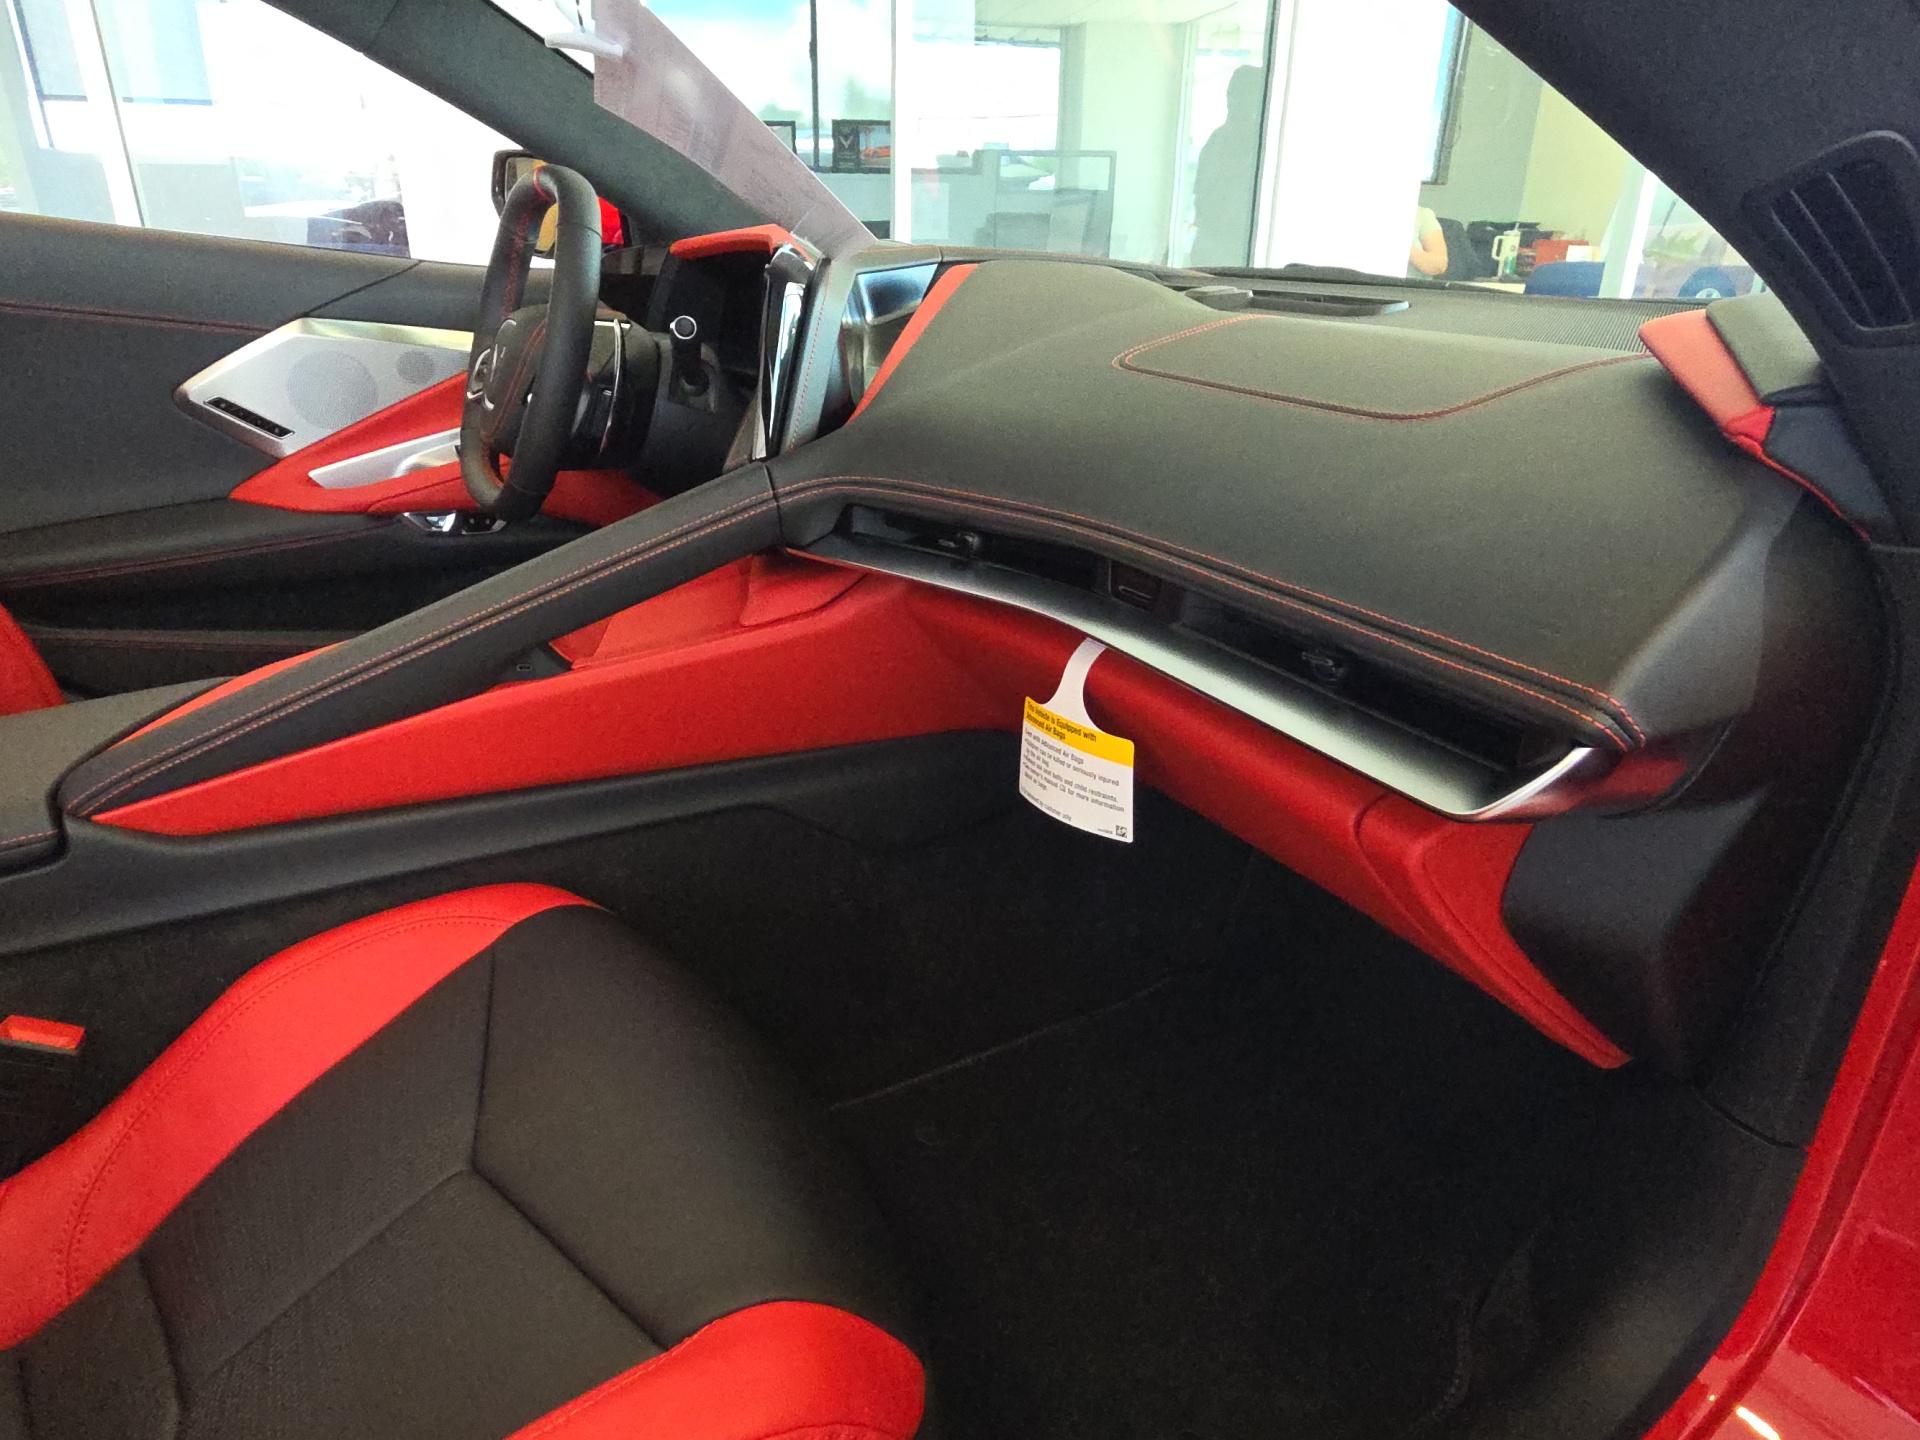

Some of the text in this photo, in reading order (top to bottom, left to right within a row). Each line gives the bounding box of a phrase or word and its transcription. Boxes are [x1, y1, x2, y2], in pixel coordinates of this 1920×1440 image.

[1026, 712, 1045, 729] Advanced
[1053, 727, 1066, 741] Bags
[1035, 706, 1050, 721] Vehicle
[1051, 715, 1056, 724] is
[1056, 719, 1082, 736] Equipped
[1083, 730, 1097, 742] with
[1039, 748, 1047, 756] can
[1053, 756, 1066, 766] killed
[1072, 766, 1096, 780] seriously
[1098, 775, 1120, 787] injured
[1041, 739, 1062, 754] Advanced
[1062, 750, 1070, 758] Air
[1070, 754, 1084, 765] Bags
[1043, 766, 1052, 776] seat
[1052, 772, 1063, 782] belts
[1064, 778, 1074, 787] and
[1074, 783, 1088, 793] child
[1089, 789, 1118, 802] restraints.
[1044, 776, 1059, 788] manual
[1067, 787, 1075, 796] for
[1075, 792, 1089, 802] more
[1090, 797, 1125, 812] information
[1044, 803, 1061, 816] customer
